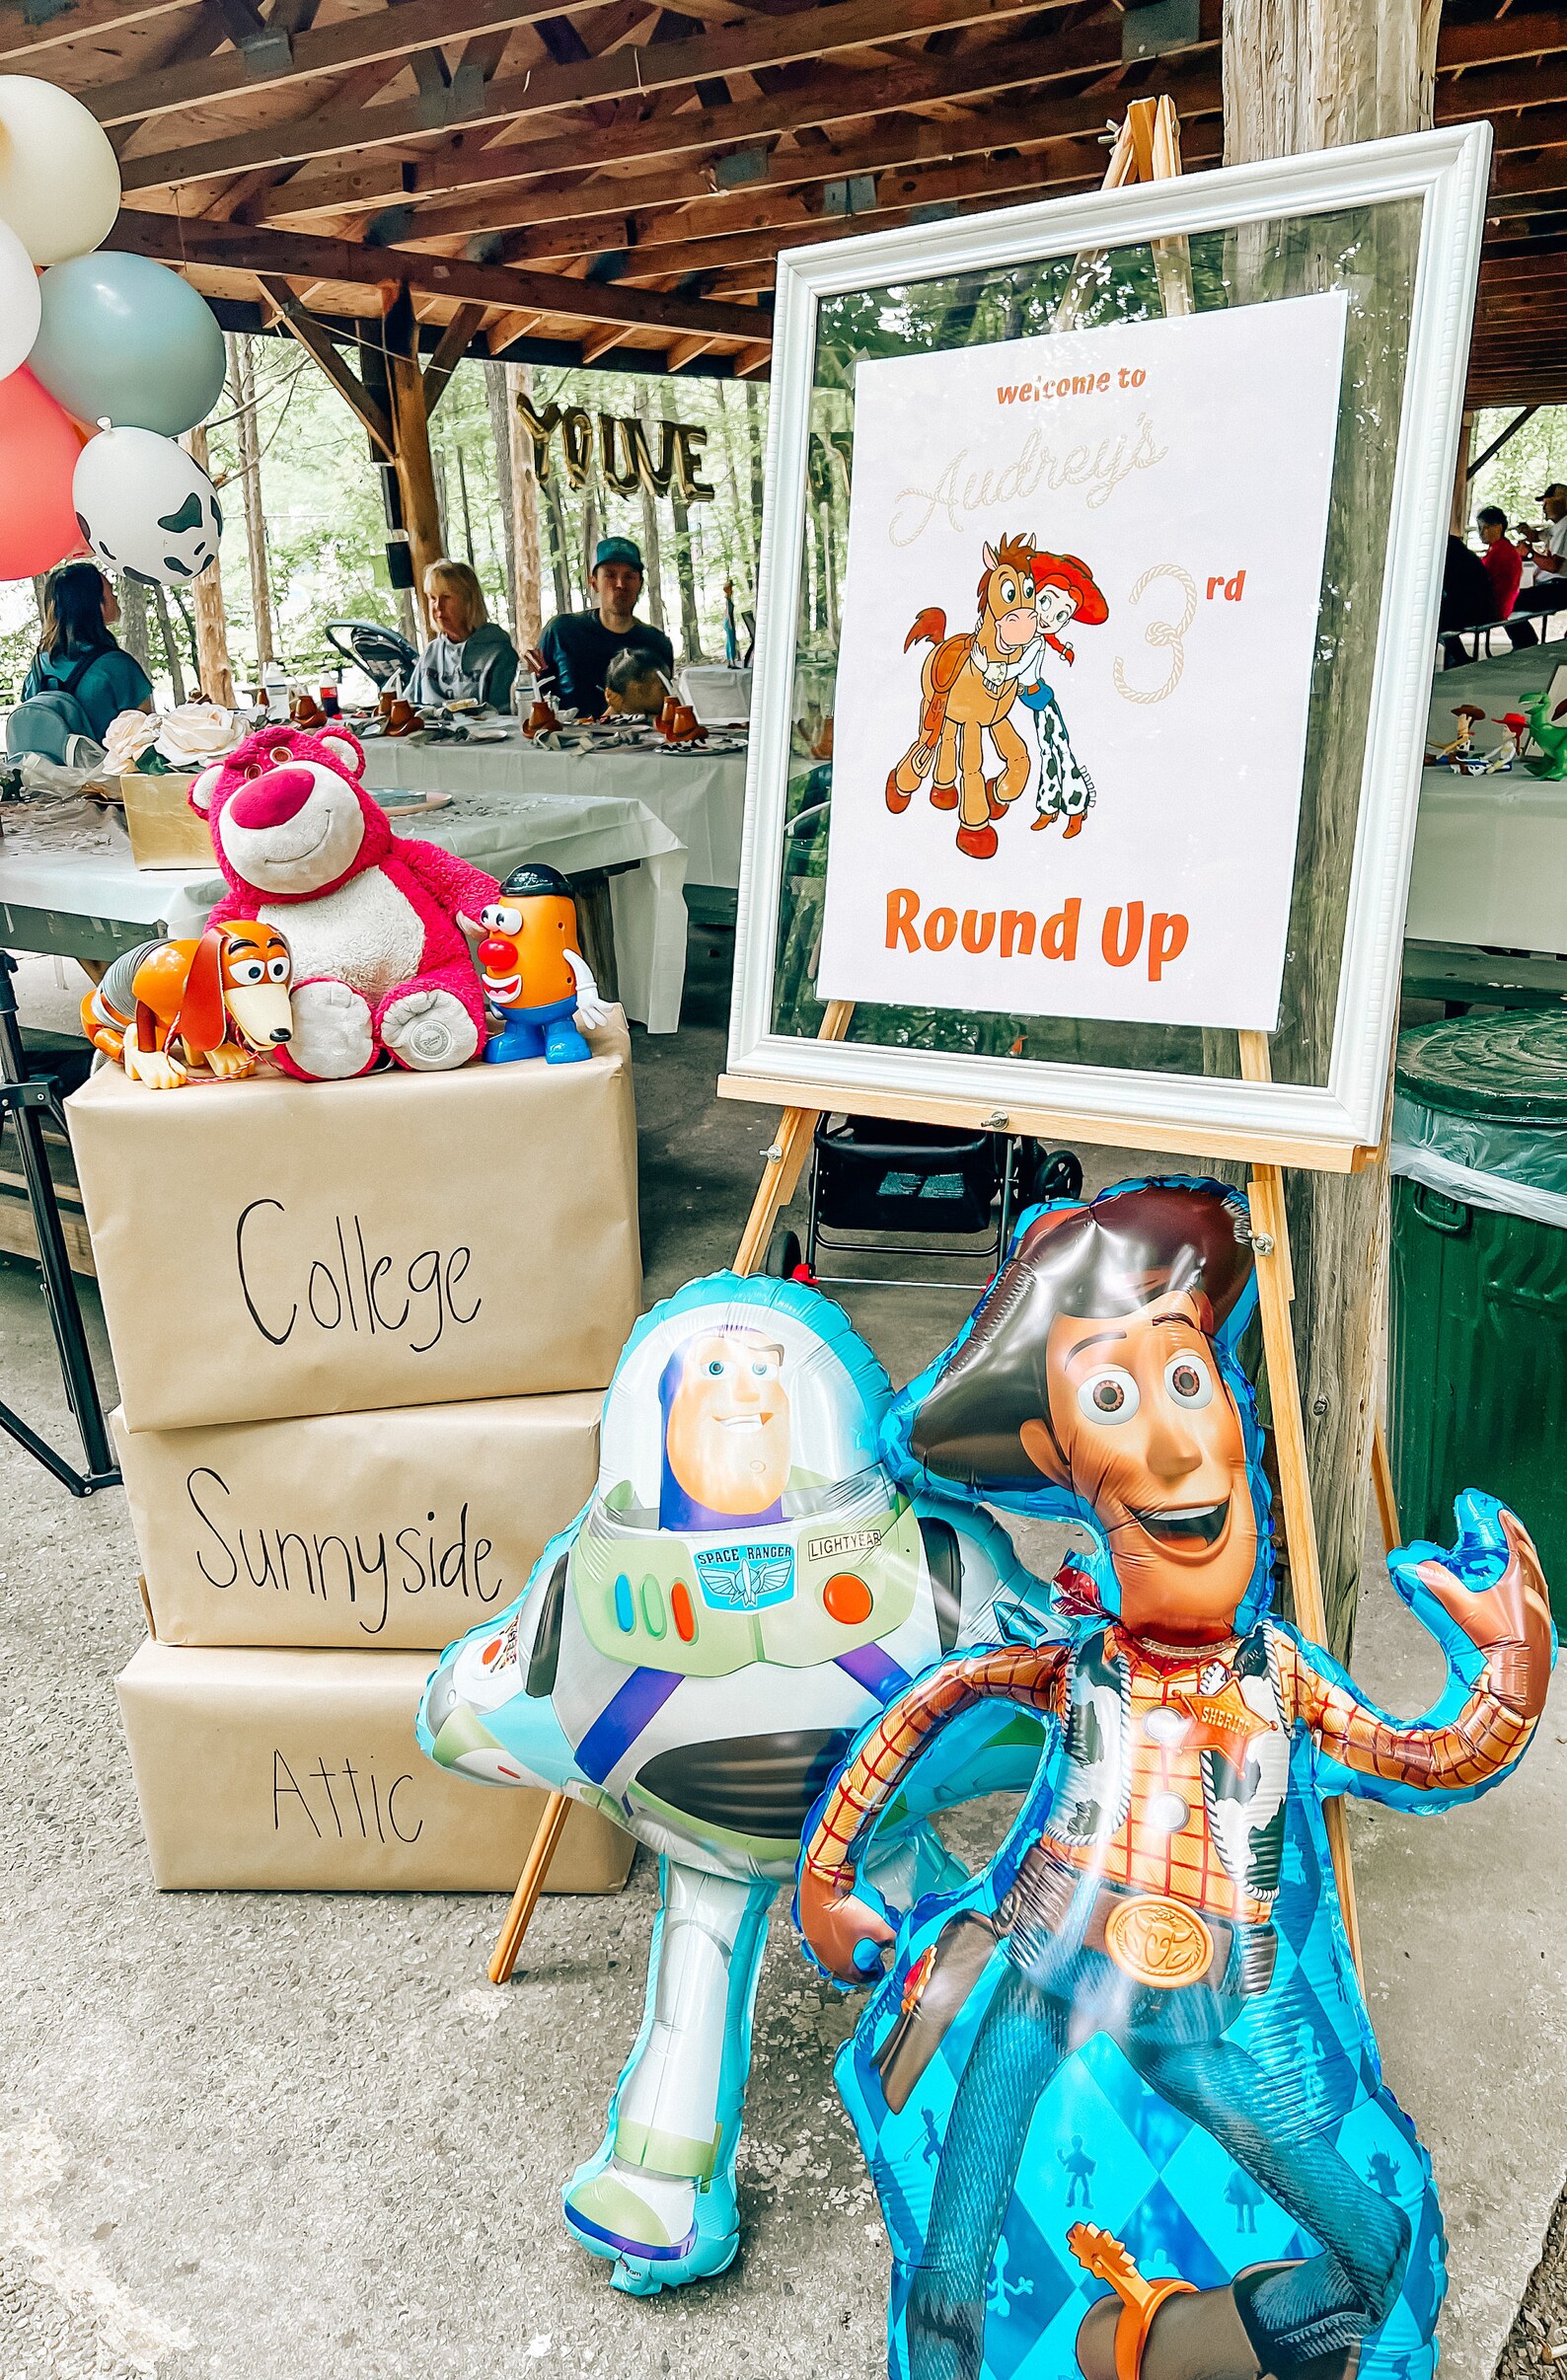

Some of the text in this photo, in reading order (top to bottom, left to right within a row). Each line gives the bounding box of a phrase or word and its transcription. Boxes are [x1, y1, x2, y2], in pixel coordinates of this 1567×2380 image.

[997, 366, 1148, 405] welcome to
[889, 411, 1168, 548] Audrey's
[885, 888, 1189, 982] Round Up
[237, 1198, 482, 1353] College
[187, 1467, 502, 1634] Sunnyside
[697, 1545, 792, 1565] SPACE RANGER
[810, 1531, 881, 1558] LIGHTYEAR
[1201, 1706, 1251, 1738] SHERIFF
[273, 1748, 423, 1844] Attic
